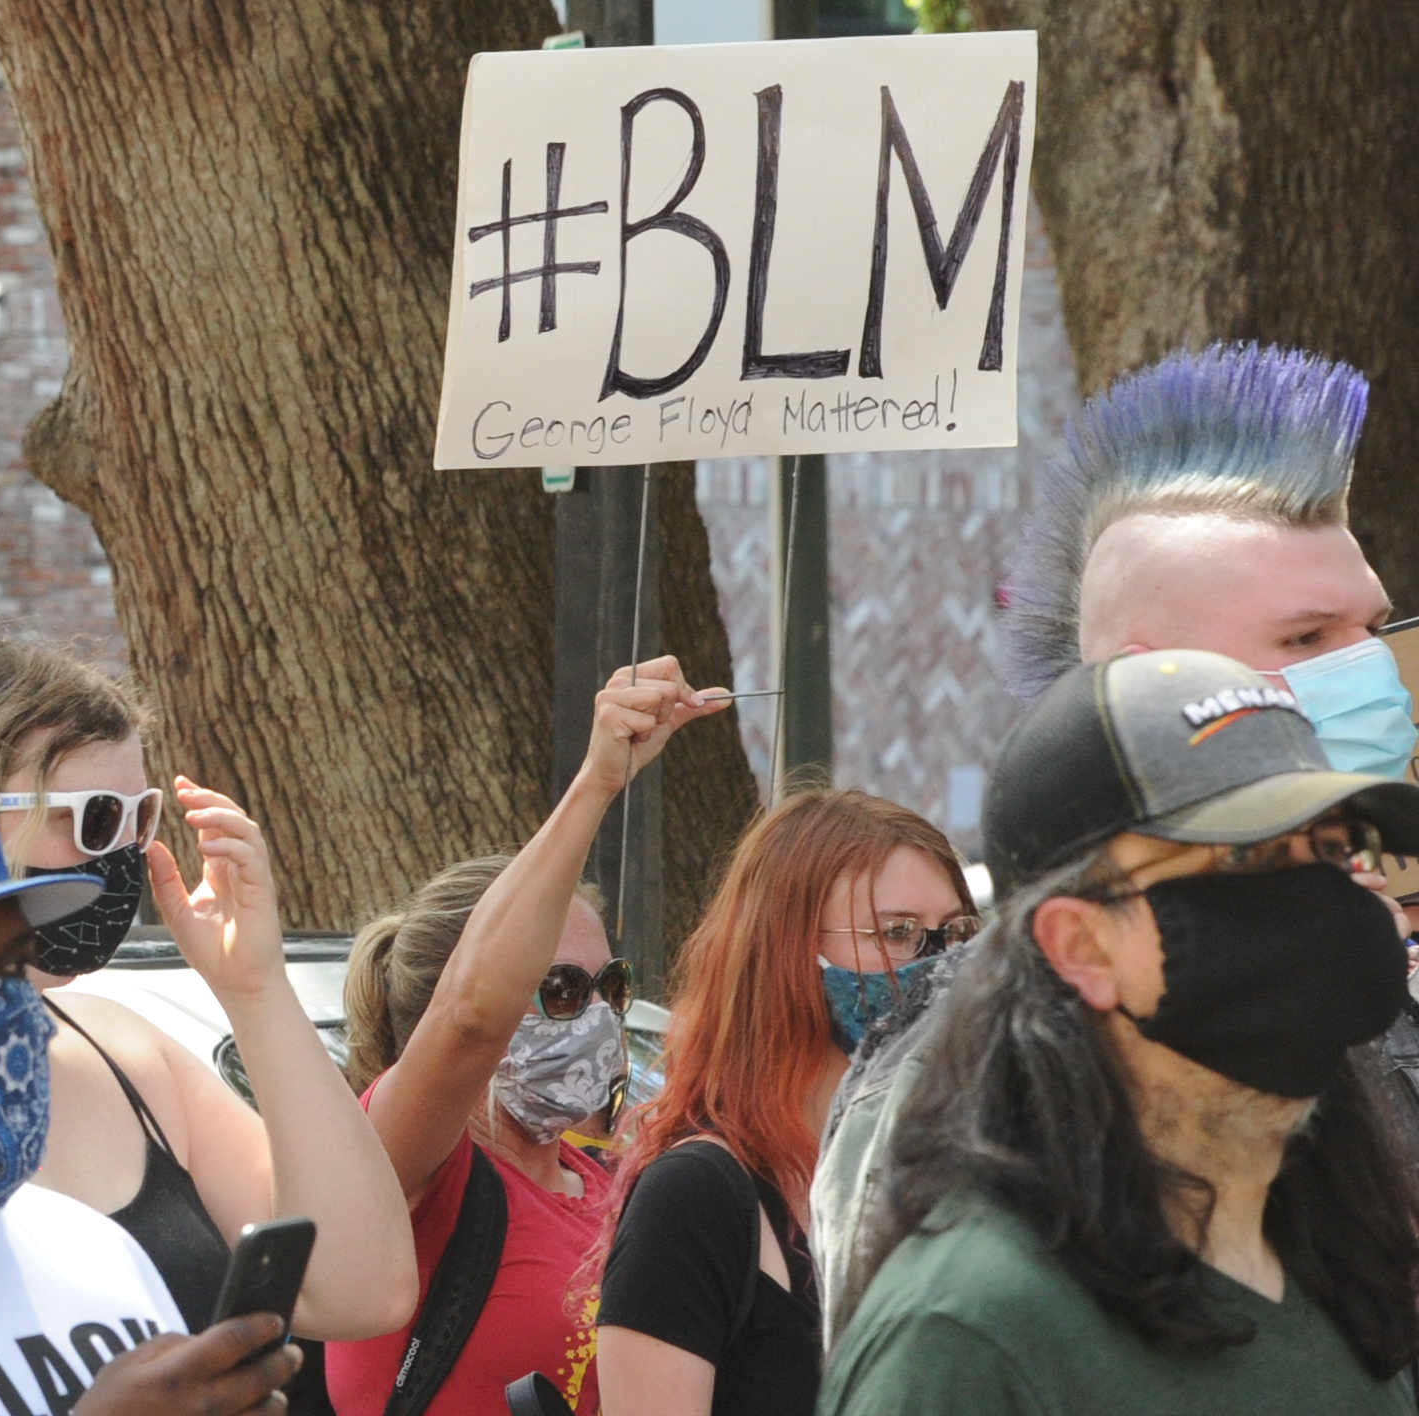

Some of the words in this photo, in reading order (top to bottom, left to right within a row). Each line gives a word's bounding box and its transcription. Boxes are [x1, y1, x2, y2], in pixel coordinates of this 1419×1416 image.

[469, 80, 1026, 402] #BLM
[472, 401, 631, 460] George
[660, 392, 753, 448] Floyd
[782, 367, 958, 437] Mattered!
